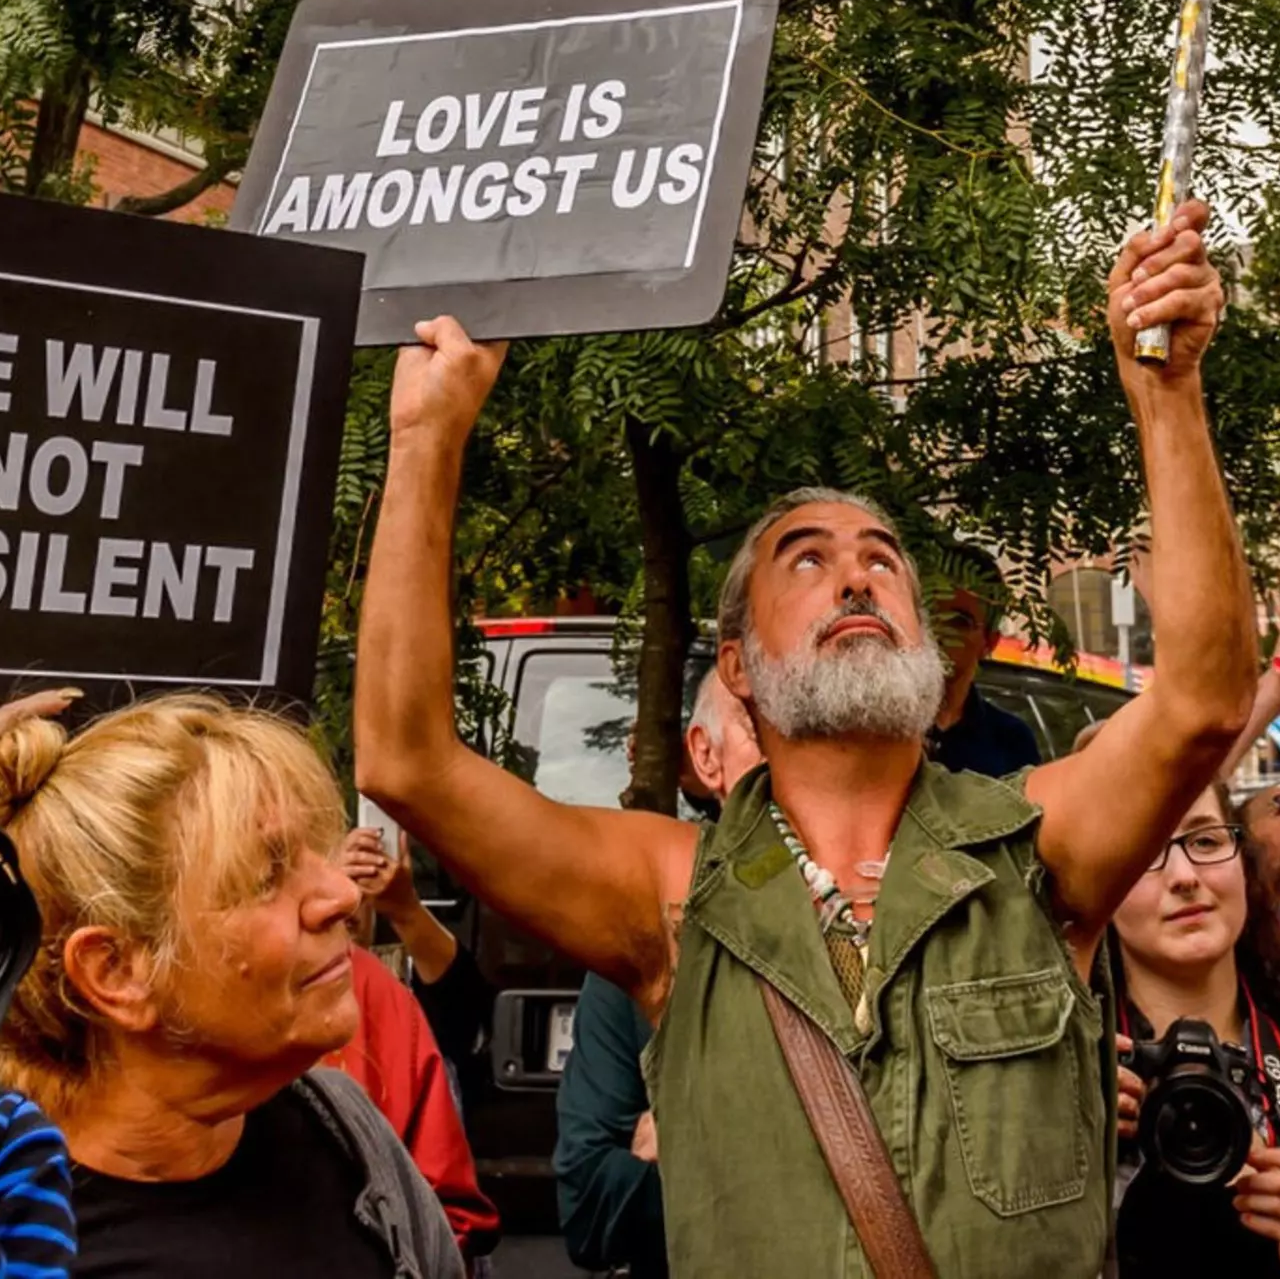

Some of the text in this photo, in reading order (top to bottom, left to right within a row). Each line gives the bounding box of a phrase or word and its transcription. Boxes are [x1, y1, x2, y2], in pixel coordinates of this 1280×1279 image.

[375, 79, 626, 157] LOVE IS
[264, 143, 705, 234] AMONGST US
[45, 339, 234, 436] WILL
